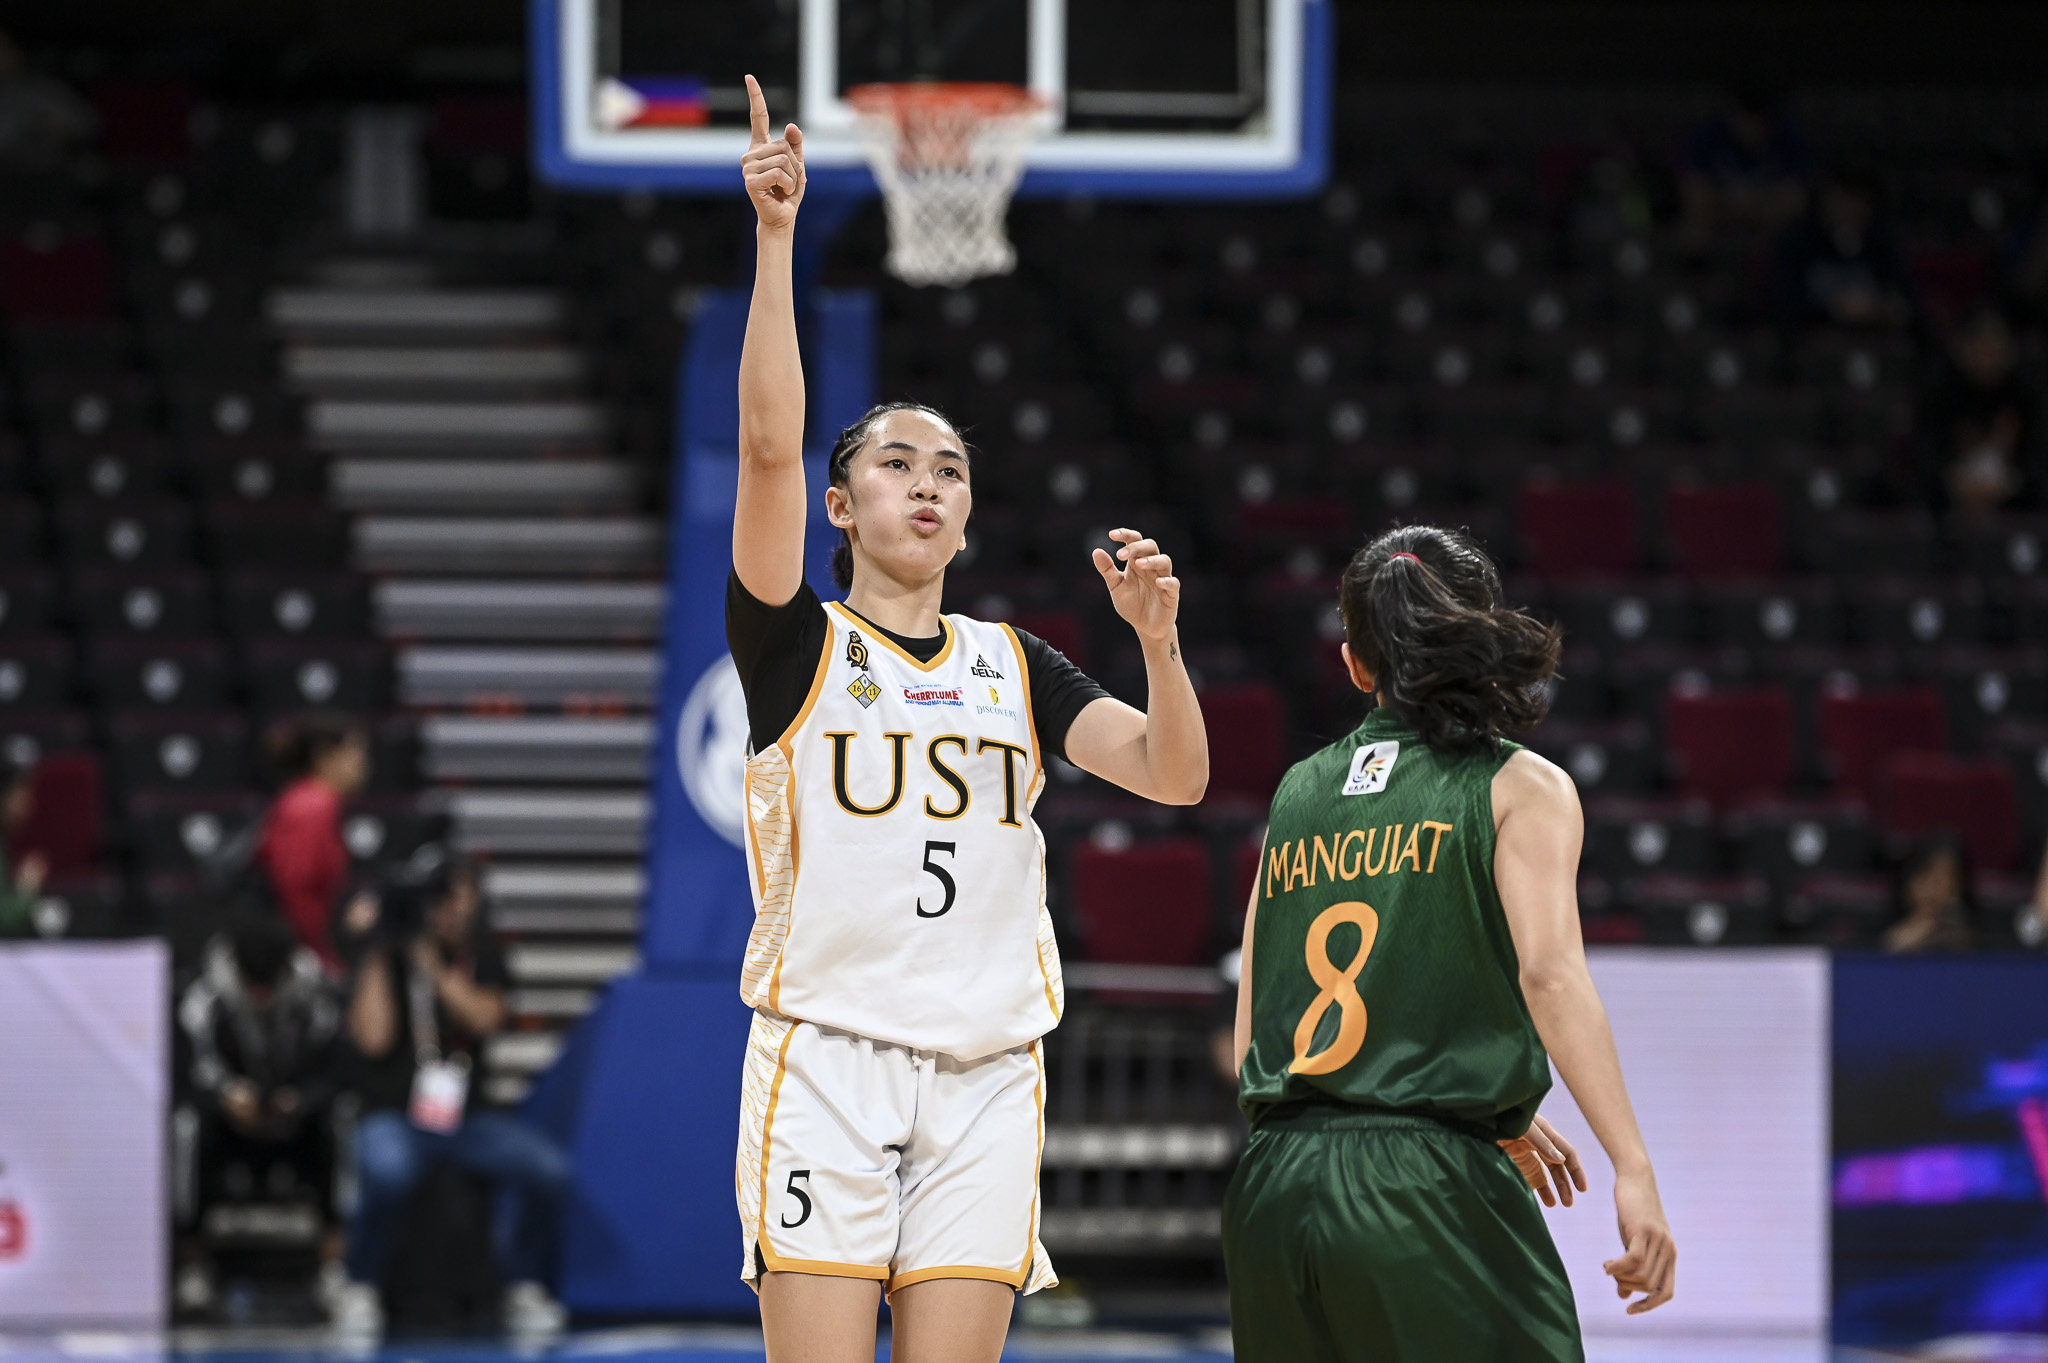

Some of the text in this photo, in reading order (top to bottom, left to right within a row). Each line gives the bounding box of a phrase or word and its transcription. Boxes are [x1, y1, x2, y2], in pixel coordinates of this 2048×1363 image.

[868, 688, 876, 696] 11
[971, 666, 1005, 680] DELTA
[976, 705, 1017, 721] DISCOVERY
[823, 731, 1028, 829] UST
[916, 840, 956, 919] 5
[1266, 820, 1453, 898] MANGUIAT
[1288, 901, 1378, 1075] 8
[781, 1169, 812, 1229] 5
